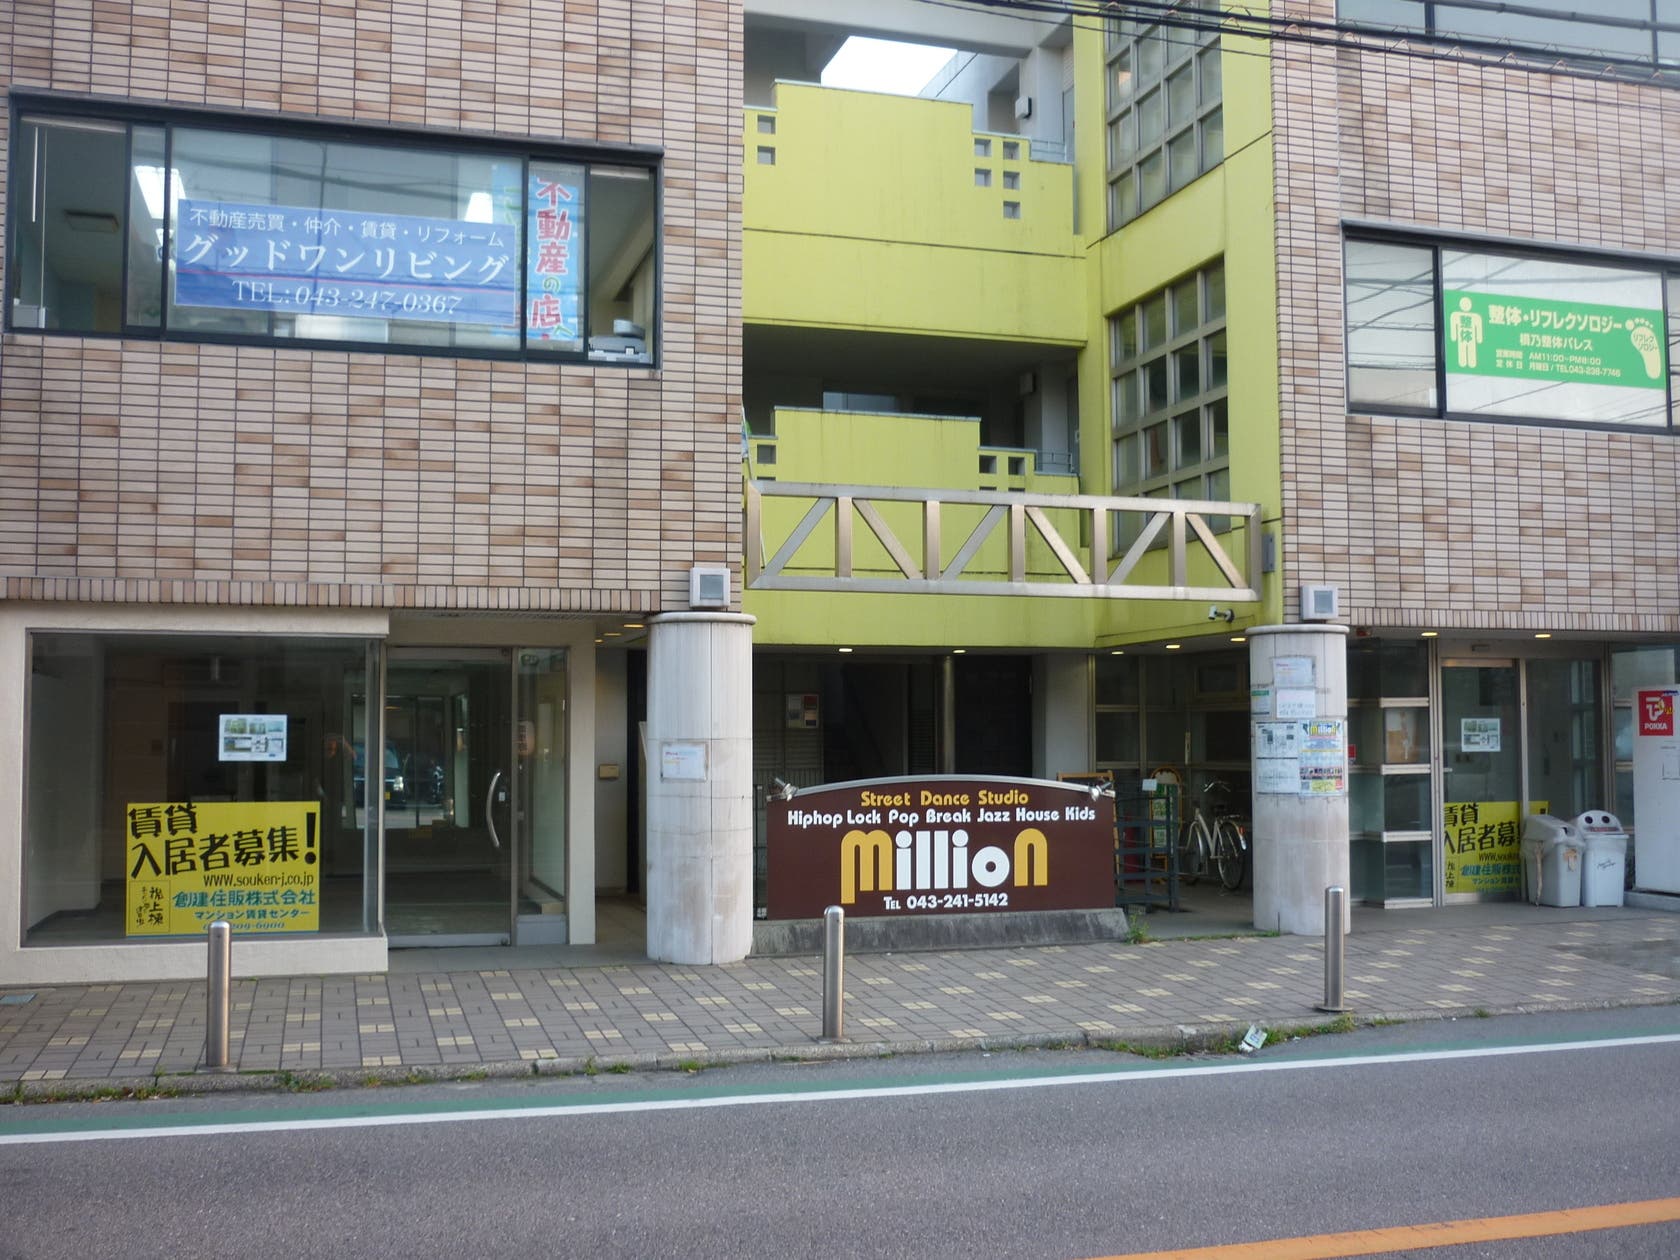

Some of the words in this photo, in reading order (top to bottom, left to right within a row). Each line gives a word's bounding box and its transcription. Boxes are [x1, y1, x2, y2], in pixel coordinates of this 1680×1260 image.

[190, 208, 504, 248] 不動産売買・仲介・賃貸・リフォーム
[184, 232, 509, 285] グッドワンリビング
[1488, 304, 1622, 333] 整体・リフレクソロジー
[1644, 722, 1668, 730] POKKA
[861, 790, 911, 807] Street
[920, 789, 970, 806] Dance
[978, 789, 1029, 805] Studio
[128, 802, 198, 839] 賃貸
[788, 810, 843, 828] Hiphop
[847, 809, 881, 825] Lock
[888, 809, 919, 828] Pop
[926, 807, 971, 824] Break
[977, 807, 1010, 824] Jazz
[1016, 806, 1060, 822] House
[1065, 806, 1096, 821] Kids
[130, 811, 317, 880] 入居者募集!
[1444, 820, 1520, 855] 入居者募
[172, 888, 316, 908] 創建住販株式会社
[907, 893, 1008, 909] 043-241-5142
[194, 908, 310, 920] マンション賃貸センター
